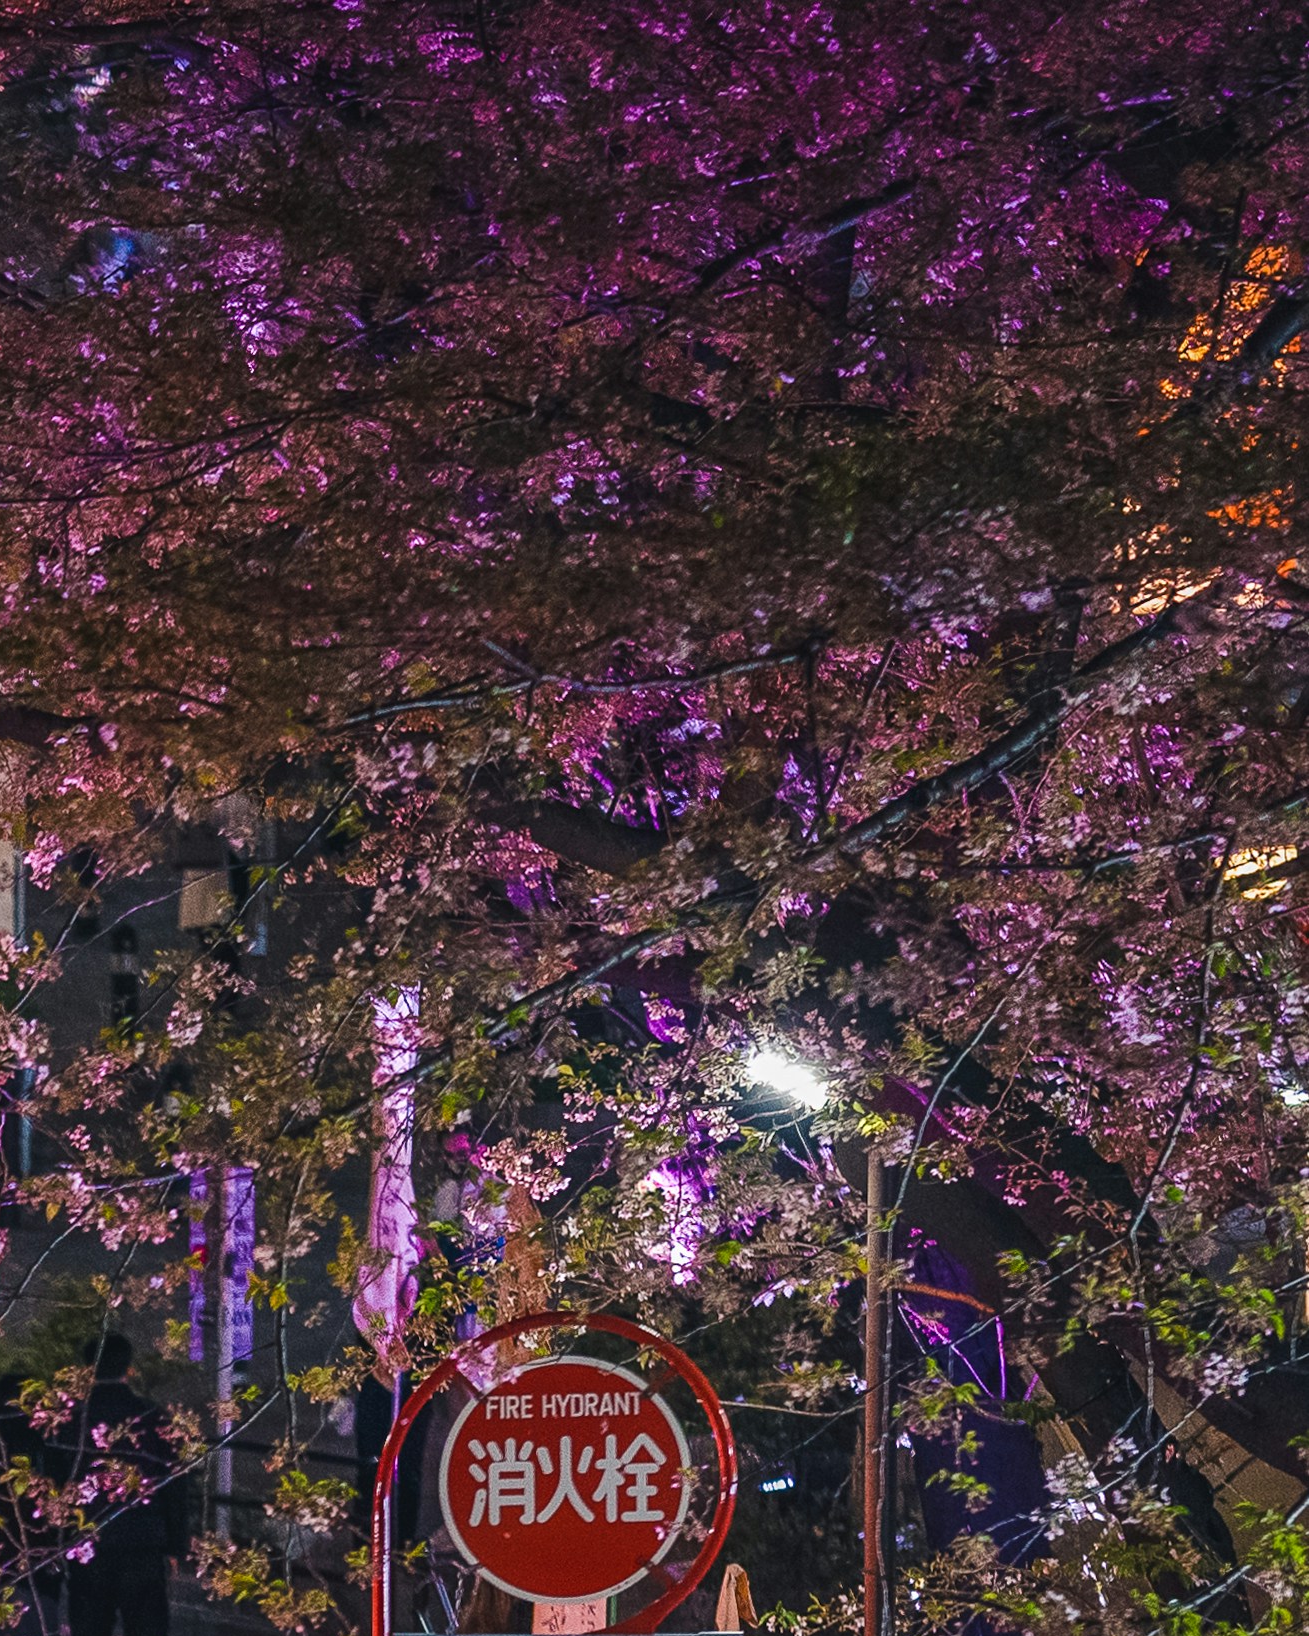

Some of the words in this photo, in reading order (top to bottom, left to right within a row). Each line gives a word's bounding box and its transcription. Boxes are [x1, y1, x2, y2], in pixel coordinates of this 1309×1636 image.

[485, 1394, 533, 1420] FIRE
[542, 1391, 642, 1418] HYDRANT
[468, 1432, 667, 1527] 消火栓
